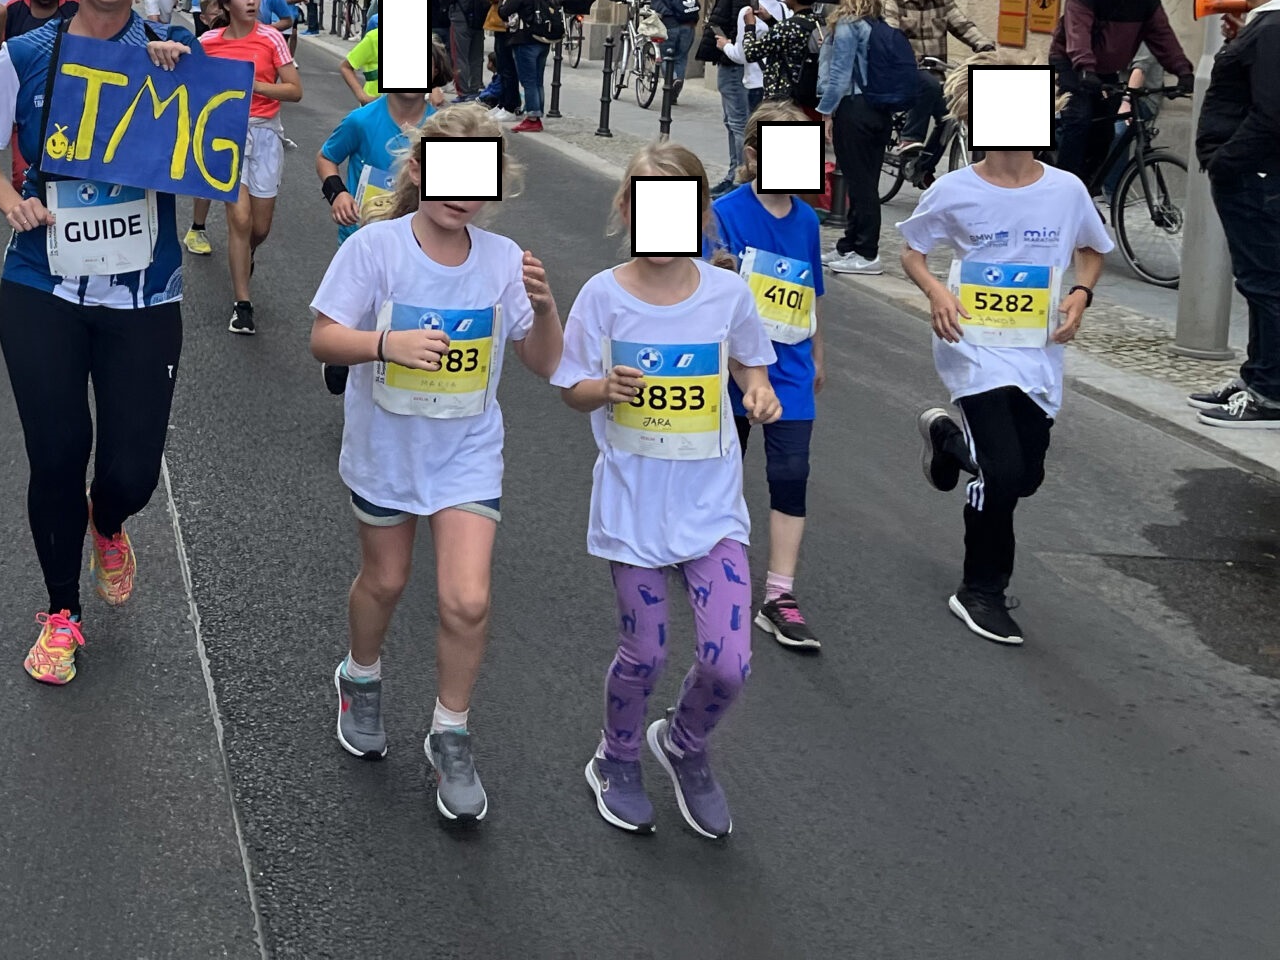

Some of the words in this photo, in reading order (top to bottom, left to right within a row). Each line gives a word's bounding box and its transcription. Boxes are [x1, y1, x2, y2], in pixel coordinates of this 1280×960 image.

[61, 63, 246, 193] TMG
[64, 214, 143, 243] GUIDE
[1023, 226, 1061, 238] mini
[764, 285, 804, 310] 4101
[975, 292, 1034, 313] 5282
[642, 417, 672, 427] JARA
